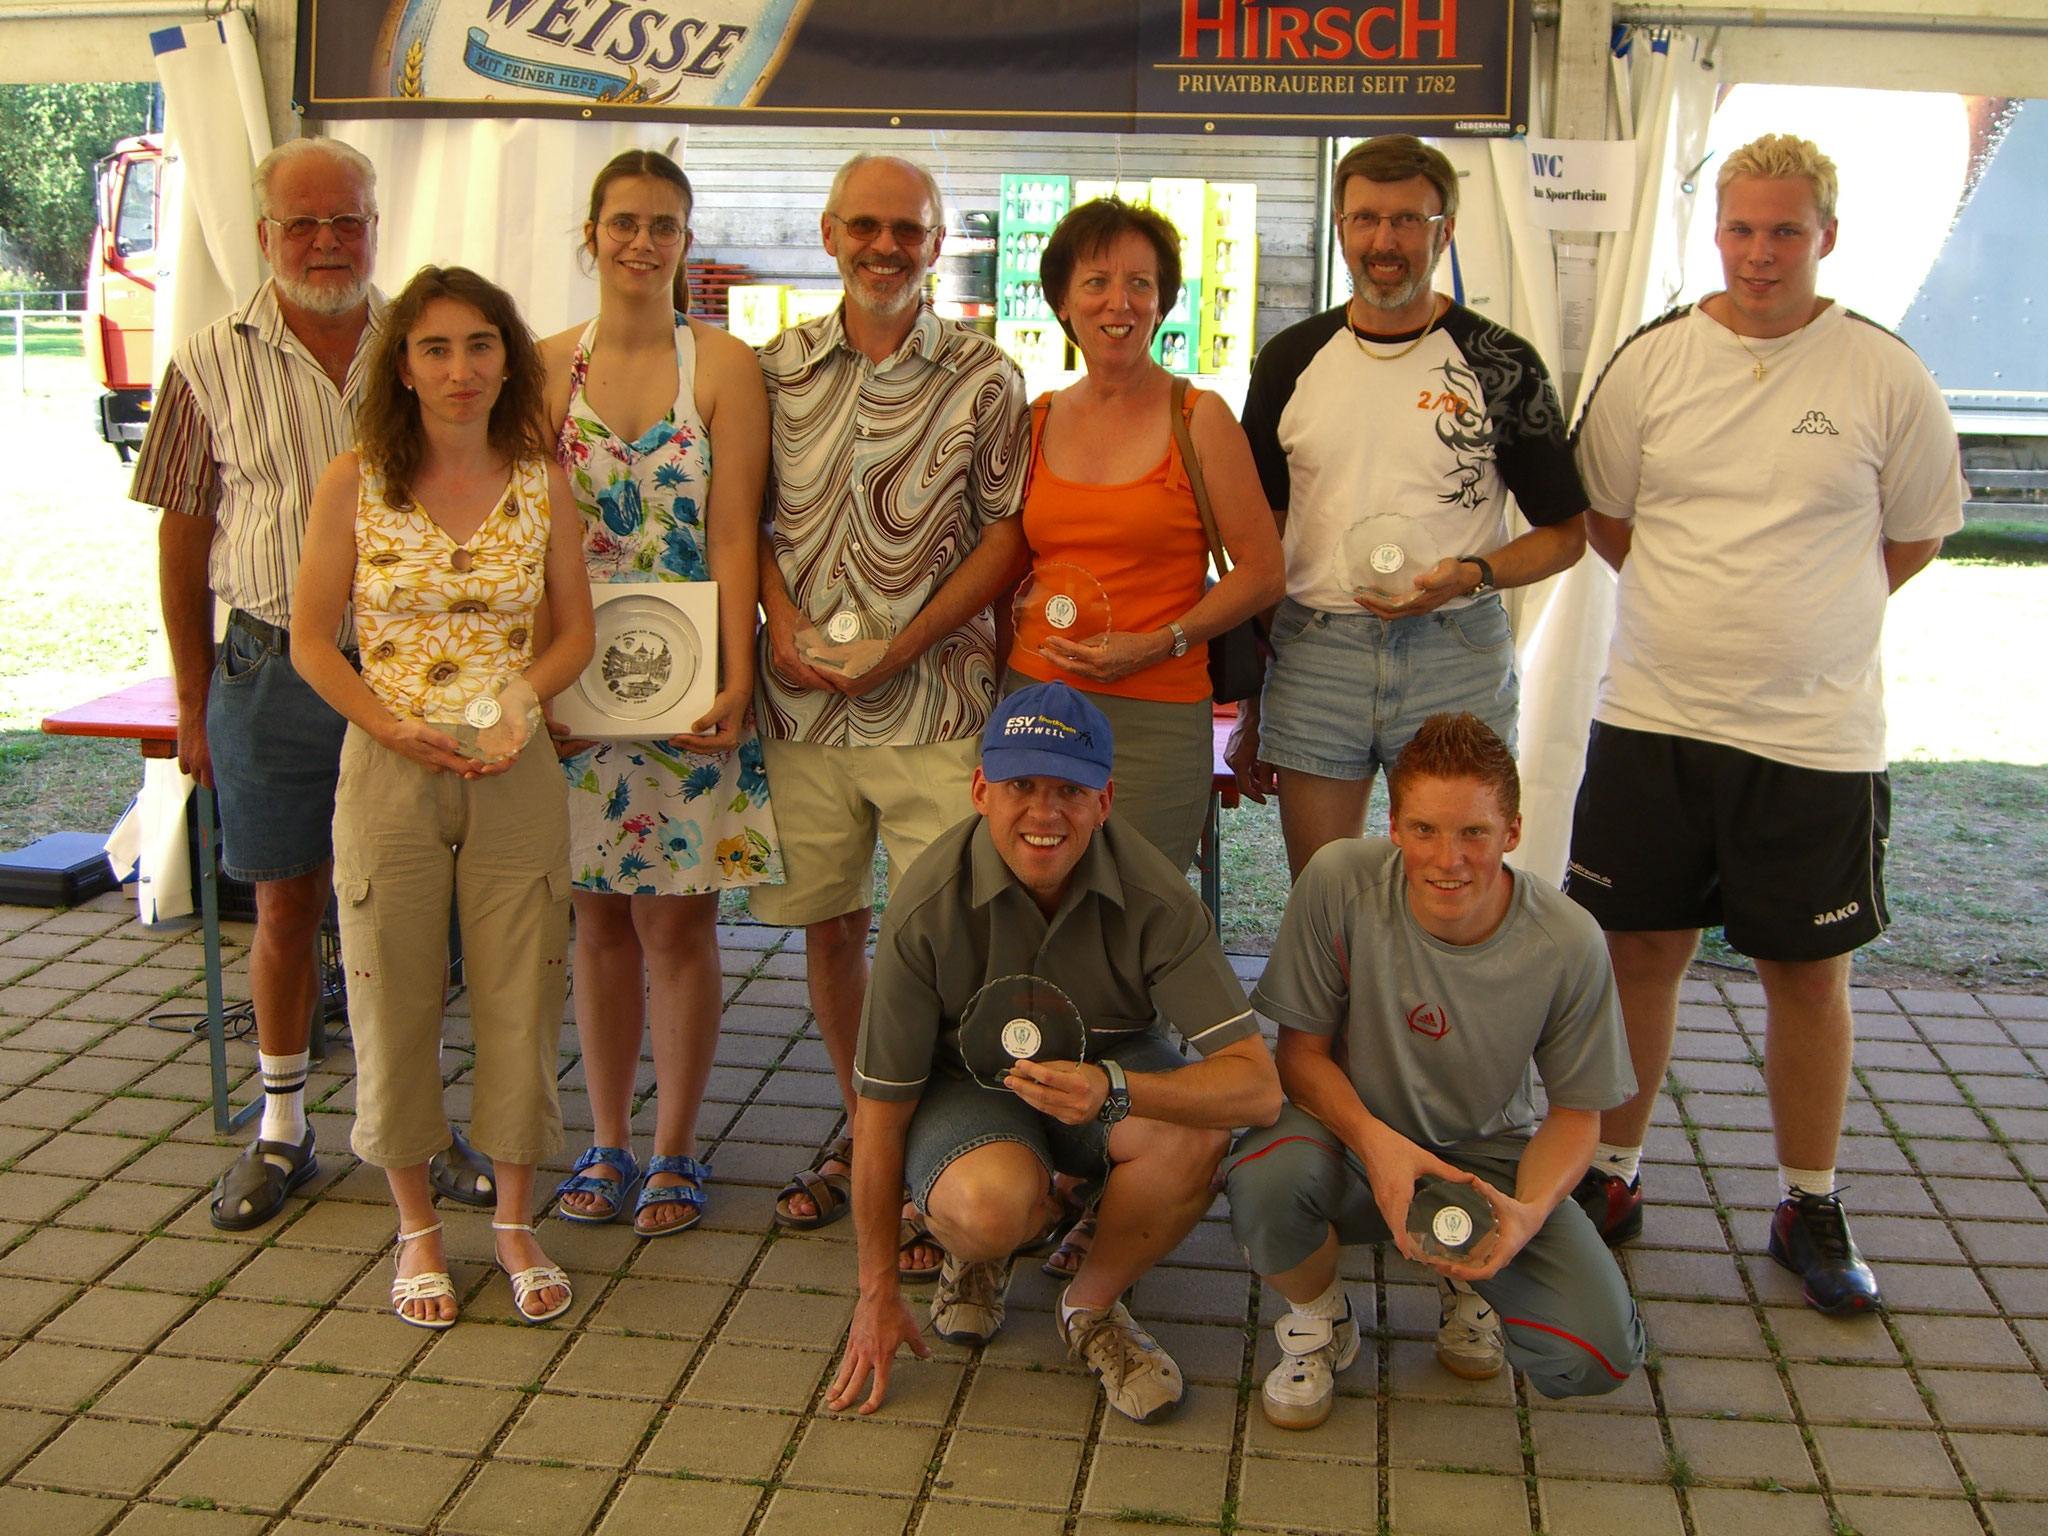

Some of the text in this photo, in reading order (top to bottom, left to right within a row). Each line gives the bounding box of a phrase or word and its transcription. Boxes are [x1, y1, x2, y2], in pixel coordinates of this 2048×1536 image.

[475, 52, 599, 92] MIT FEINER HEFE
[1178, 74, 1457, 95] PRIVATBRAUEREI SEIT 1782
[1531, 153, 1564, 178] WC
[1546, 187, 1608, 203] Sportheim
[1006, 716, 1036, 727] ESV
[1004, 727, 1065, 738] ROTTWEIL
[1813, 901, 1861, 927] JAKO
